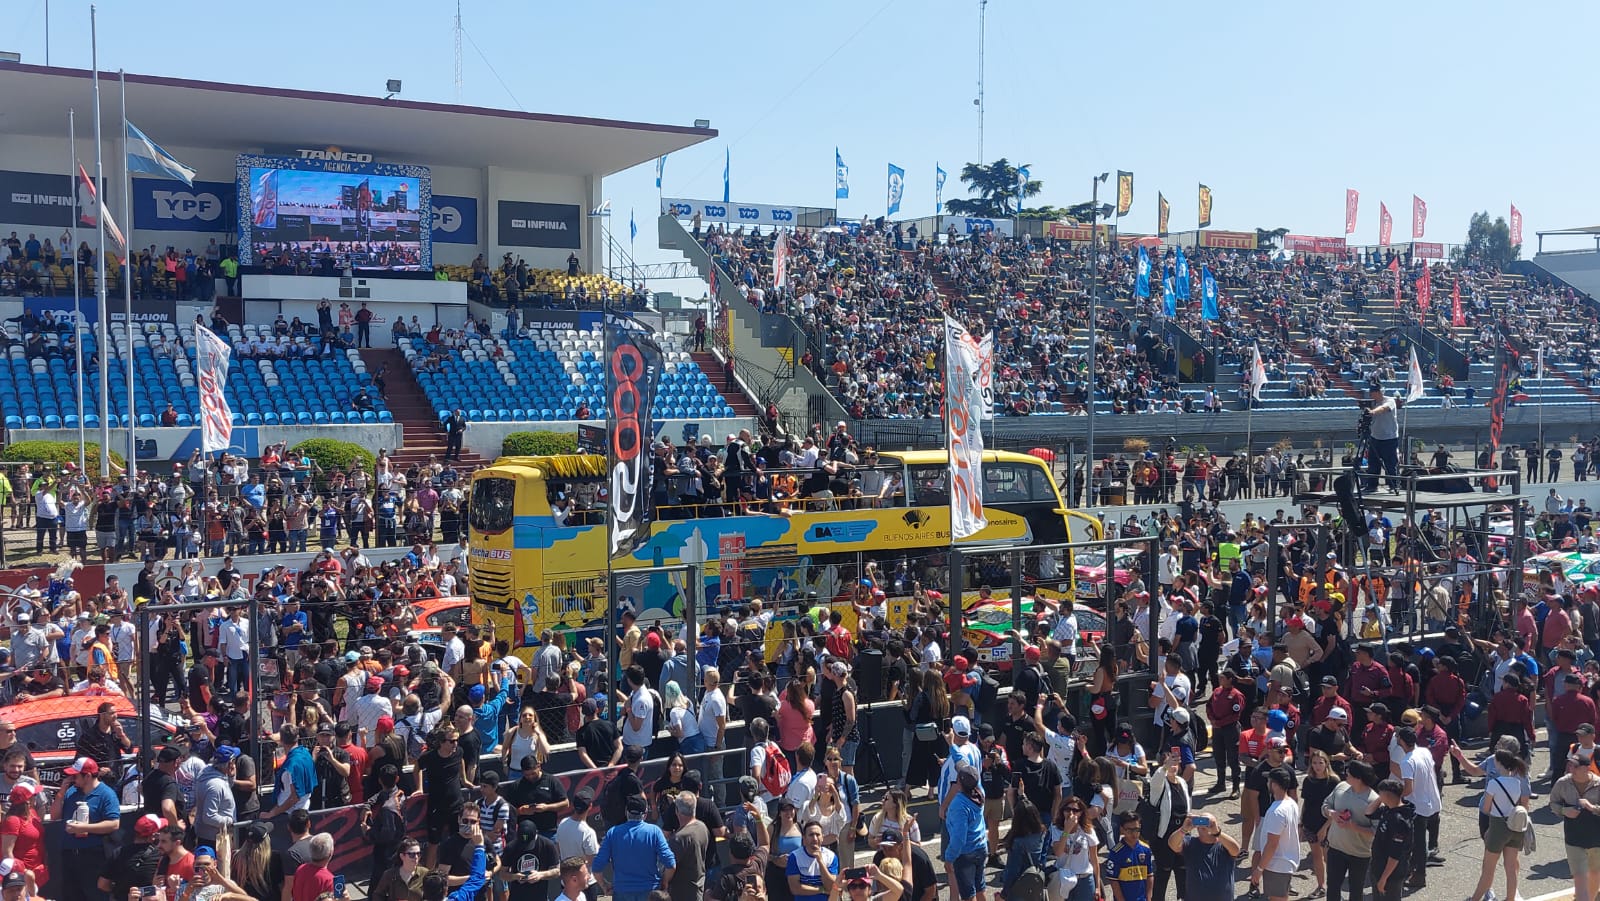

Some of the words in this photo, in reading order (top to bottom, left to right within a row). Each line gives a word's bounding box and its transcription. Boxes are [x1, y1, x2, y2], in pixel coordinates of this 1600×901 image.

[296, 149, 373, 163] TANGO
[323, 162, 351, 173] AGENCIA
[33, 193, 80, 206] INFIN
[527, 219, 568, 231] INFINIA
[1205, 233, 1252, 249] PIRELLI
[988, 516, 1018, 526] nosaires
[815, 526, 832, 539] BA
[883, 533, 914, 542] BUENOS
[915, 532, 935, 540] AIRES
[935, 530, 951, 539] BUS
[490, 549, 512, 560] BUS
[57, 727, 76, 739] 65
